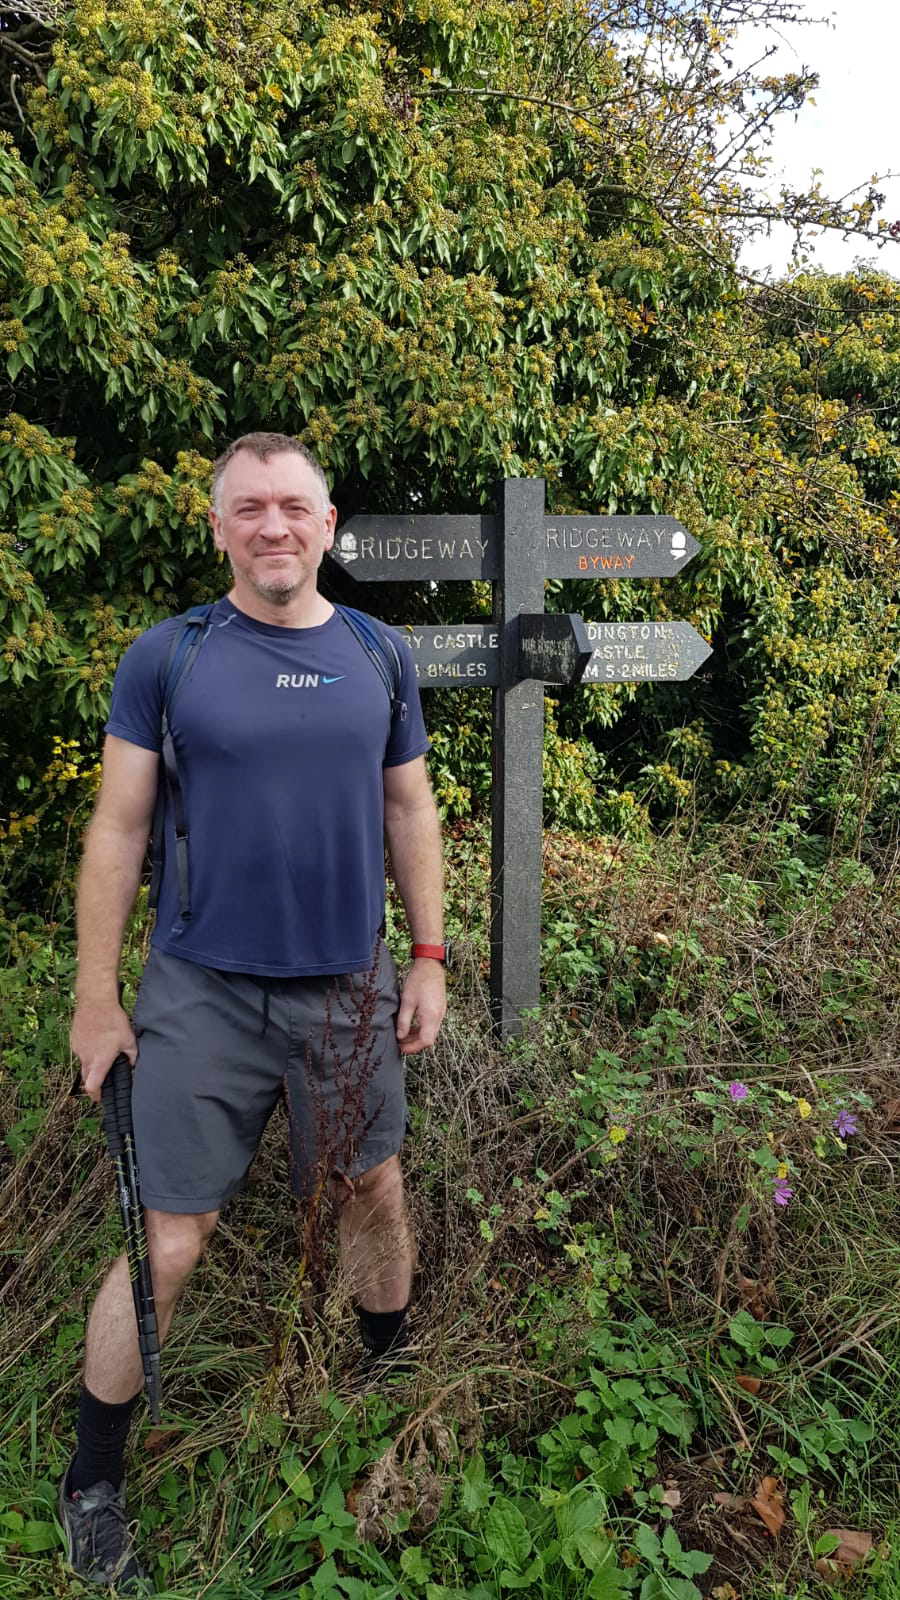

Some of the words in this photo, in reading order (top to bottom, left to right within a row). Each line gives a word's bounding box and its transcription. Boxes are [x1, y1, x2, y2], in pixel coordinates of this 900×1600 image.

[546, 528, 666, 549] RIDGEWAY
[361, 537, 489, 560] RIDGEWAY
[578, 554, 635, 571] BYWAY
[433, 633, 499, 649] CASTLE
[276, 674, 319, 688] RUN
